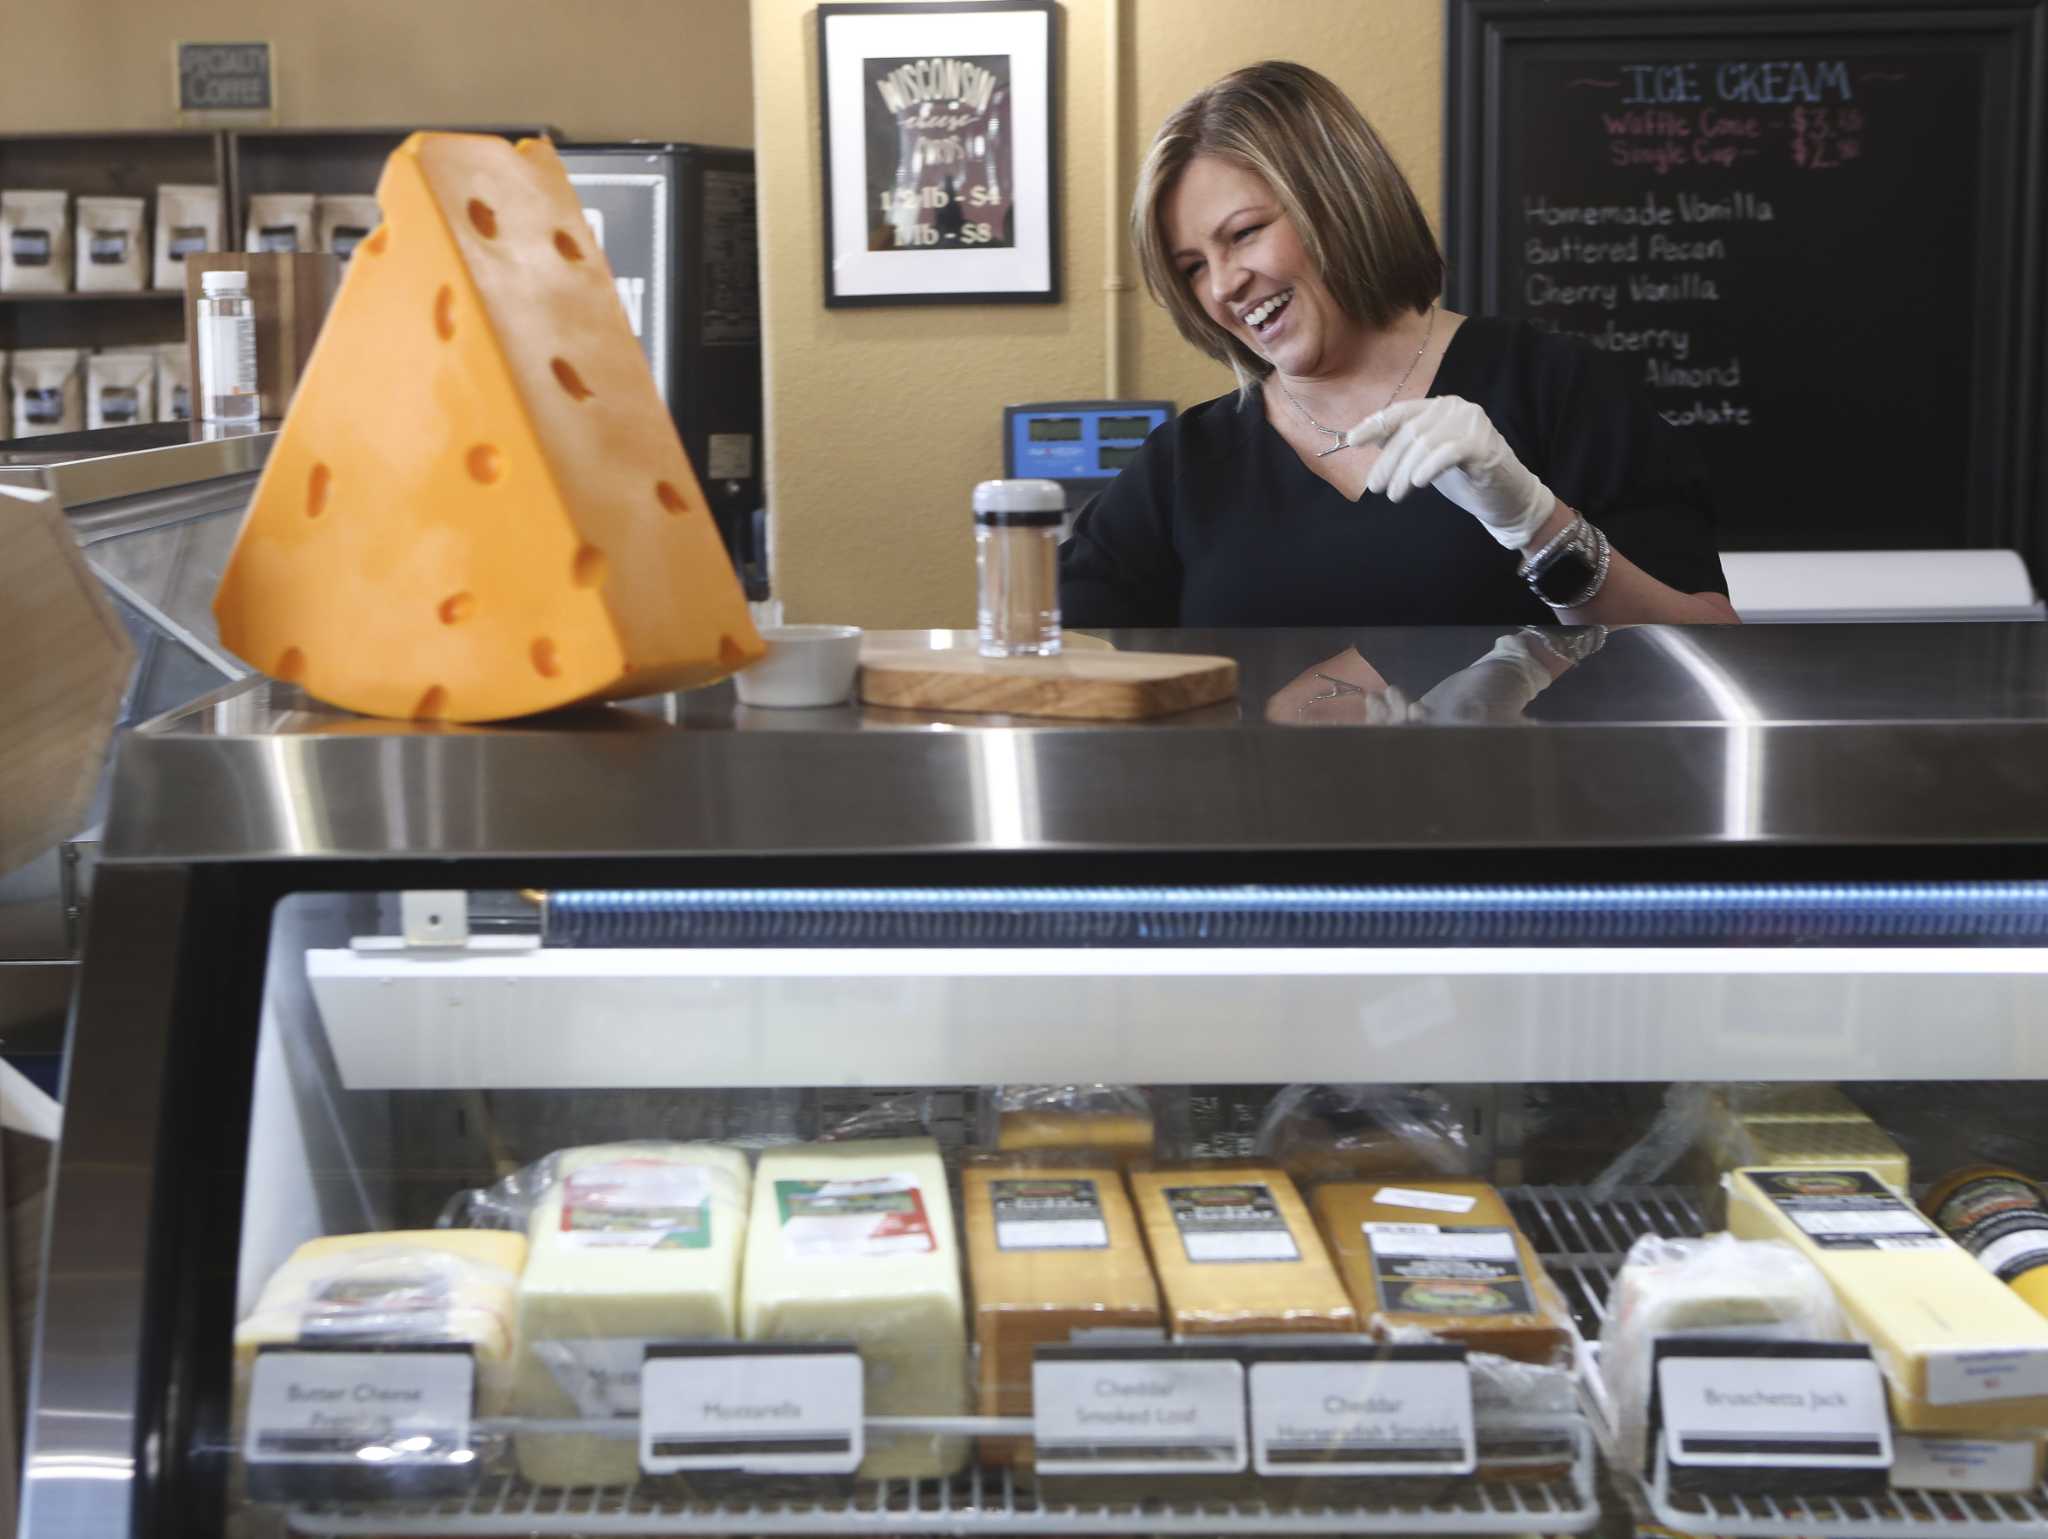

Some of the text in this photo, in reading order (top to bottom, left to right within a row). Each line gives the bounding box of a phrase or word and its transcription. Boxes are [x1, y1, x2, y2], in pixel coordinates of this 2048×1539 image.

[1619, 60, 1853, 104] ICE CREAM
[1525, 190, 1776, 226] Homemade Vanilla
[1525, 233, 1726, 264] Buttered Pecan
[1527, 272, 1721, 311] Cherry Vanilla
[1645, 356, 1741, 387] Almond
